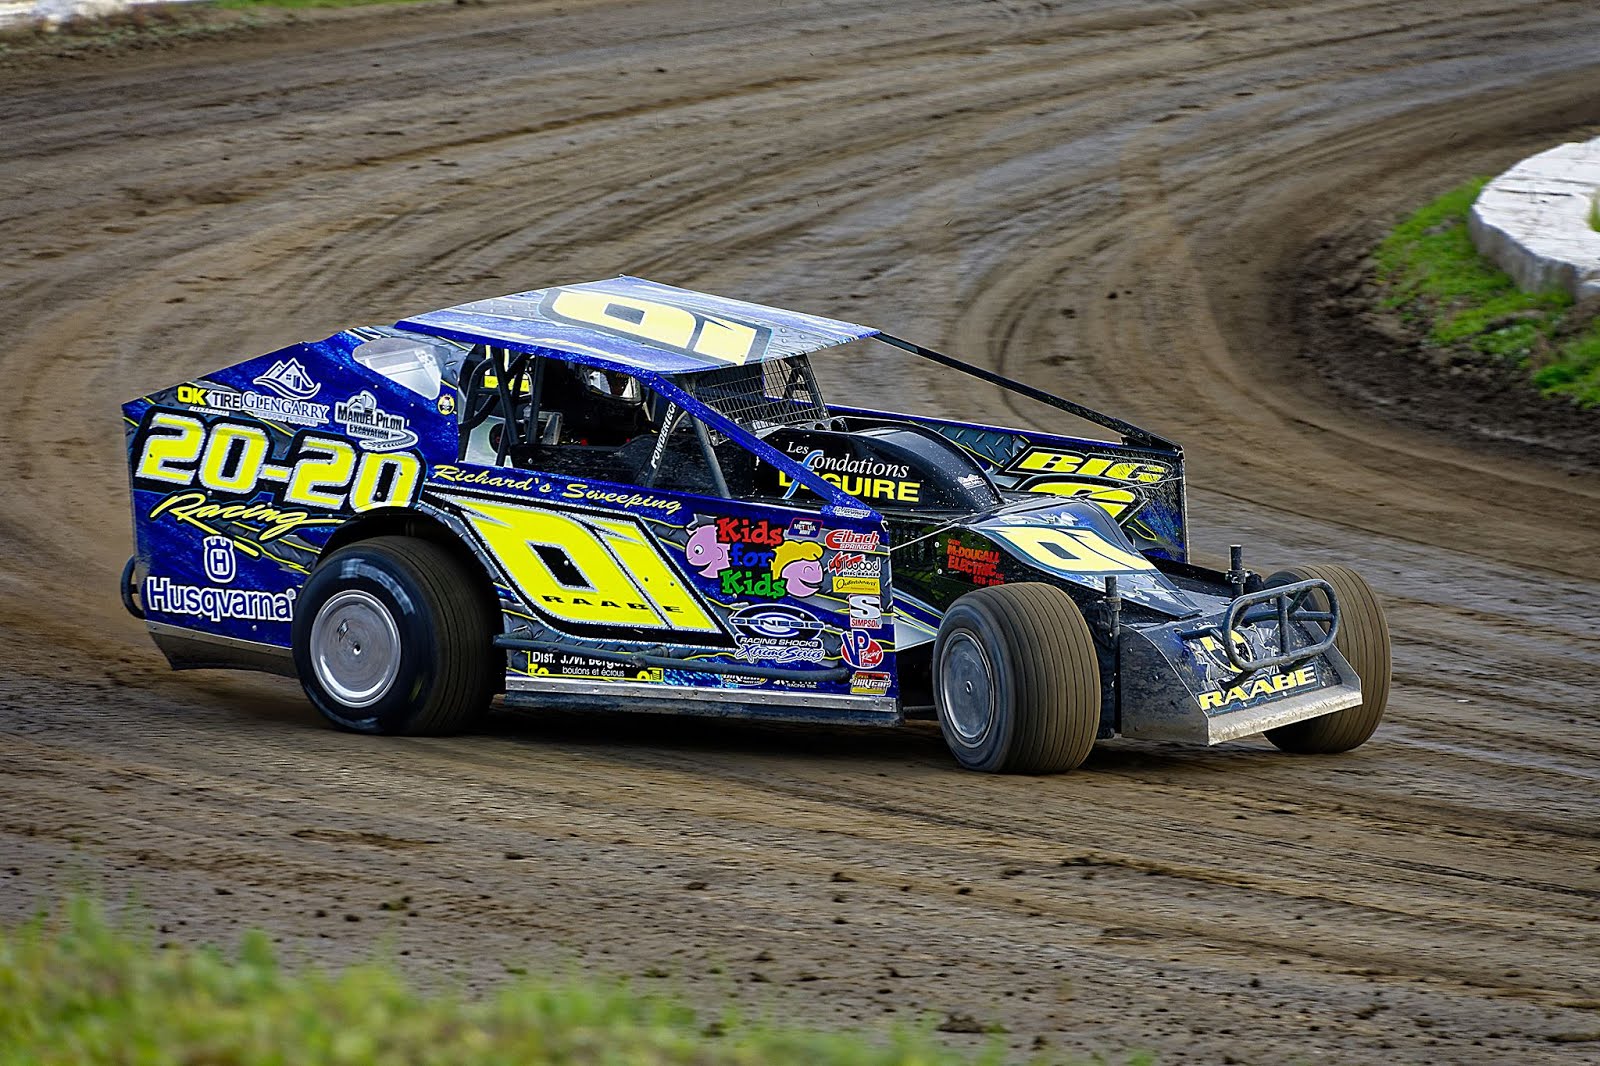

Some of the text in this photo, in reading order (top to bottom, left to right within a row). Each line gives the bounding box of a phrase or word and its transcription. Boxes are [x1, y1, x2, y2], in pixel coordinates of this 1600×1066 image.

[177, 386, 242, 409] OK TIRE
[243, 392, 329, 420] GLENGARRY
[337, 404, 404, 430] MANUEL PILON
[349, 425, 390, 439] EXCAVATION
[787, 441, 809, 455] Les
[135, 412, 422, 512] 20-20
[1017, 451, 1166, 483] BIG
[432, 464, 682, 515] Richard's Sweeping
[150, 493, 346, 540] Racing
[717, 517, 783, 546] Kids
[825, 529, 879, 550] Eibach
[730, 542, 774, 567] for
[840, 543, 874, 551] SPRINGS
[948, 555, 997, 577] ELECTRIC
[720, 569, 786, 599] Kids
[147, 577, 294, 622] Husqvarna
[541, 595, 684, 614] RAABE
[730, 618, 825, 629] GENESIS
[740, 637, 819, 648] RACING SHOCKS
[841, 630, 870, 667] VP
[562, 666, 590, 675] boulons
[601, 668, 625, 677] écrous
[1198, 666, 1318, 710] RAABE
